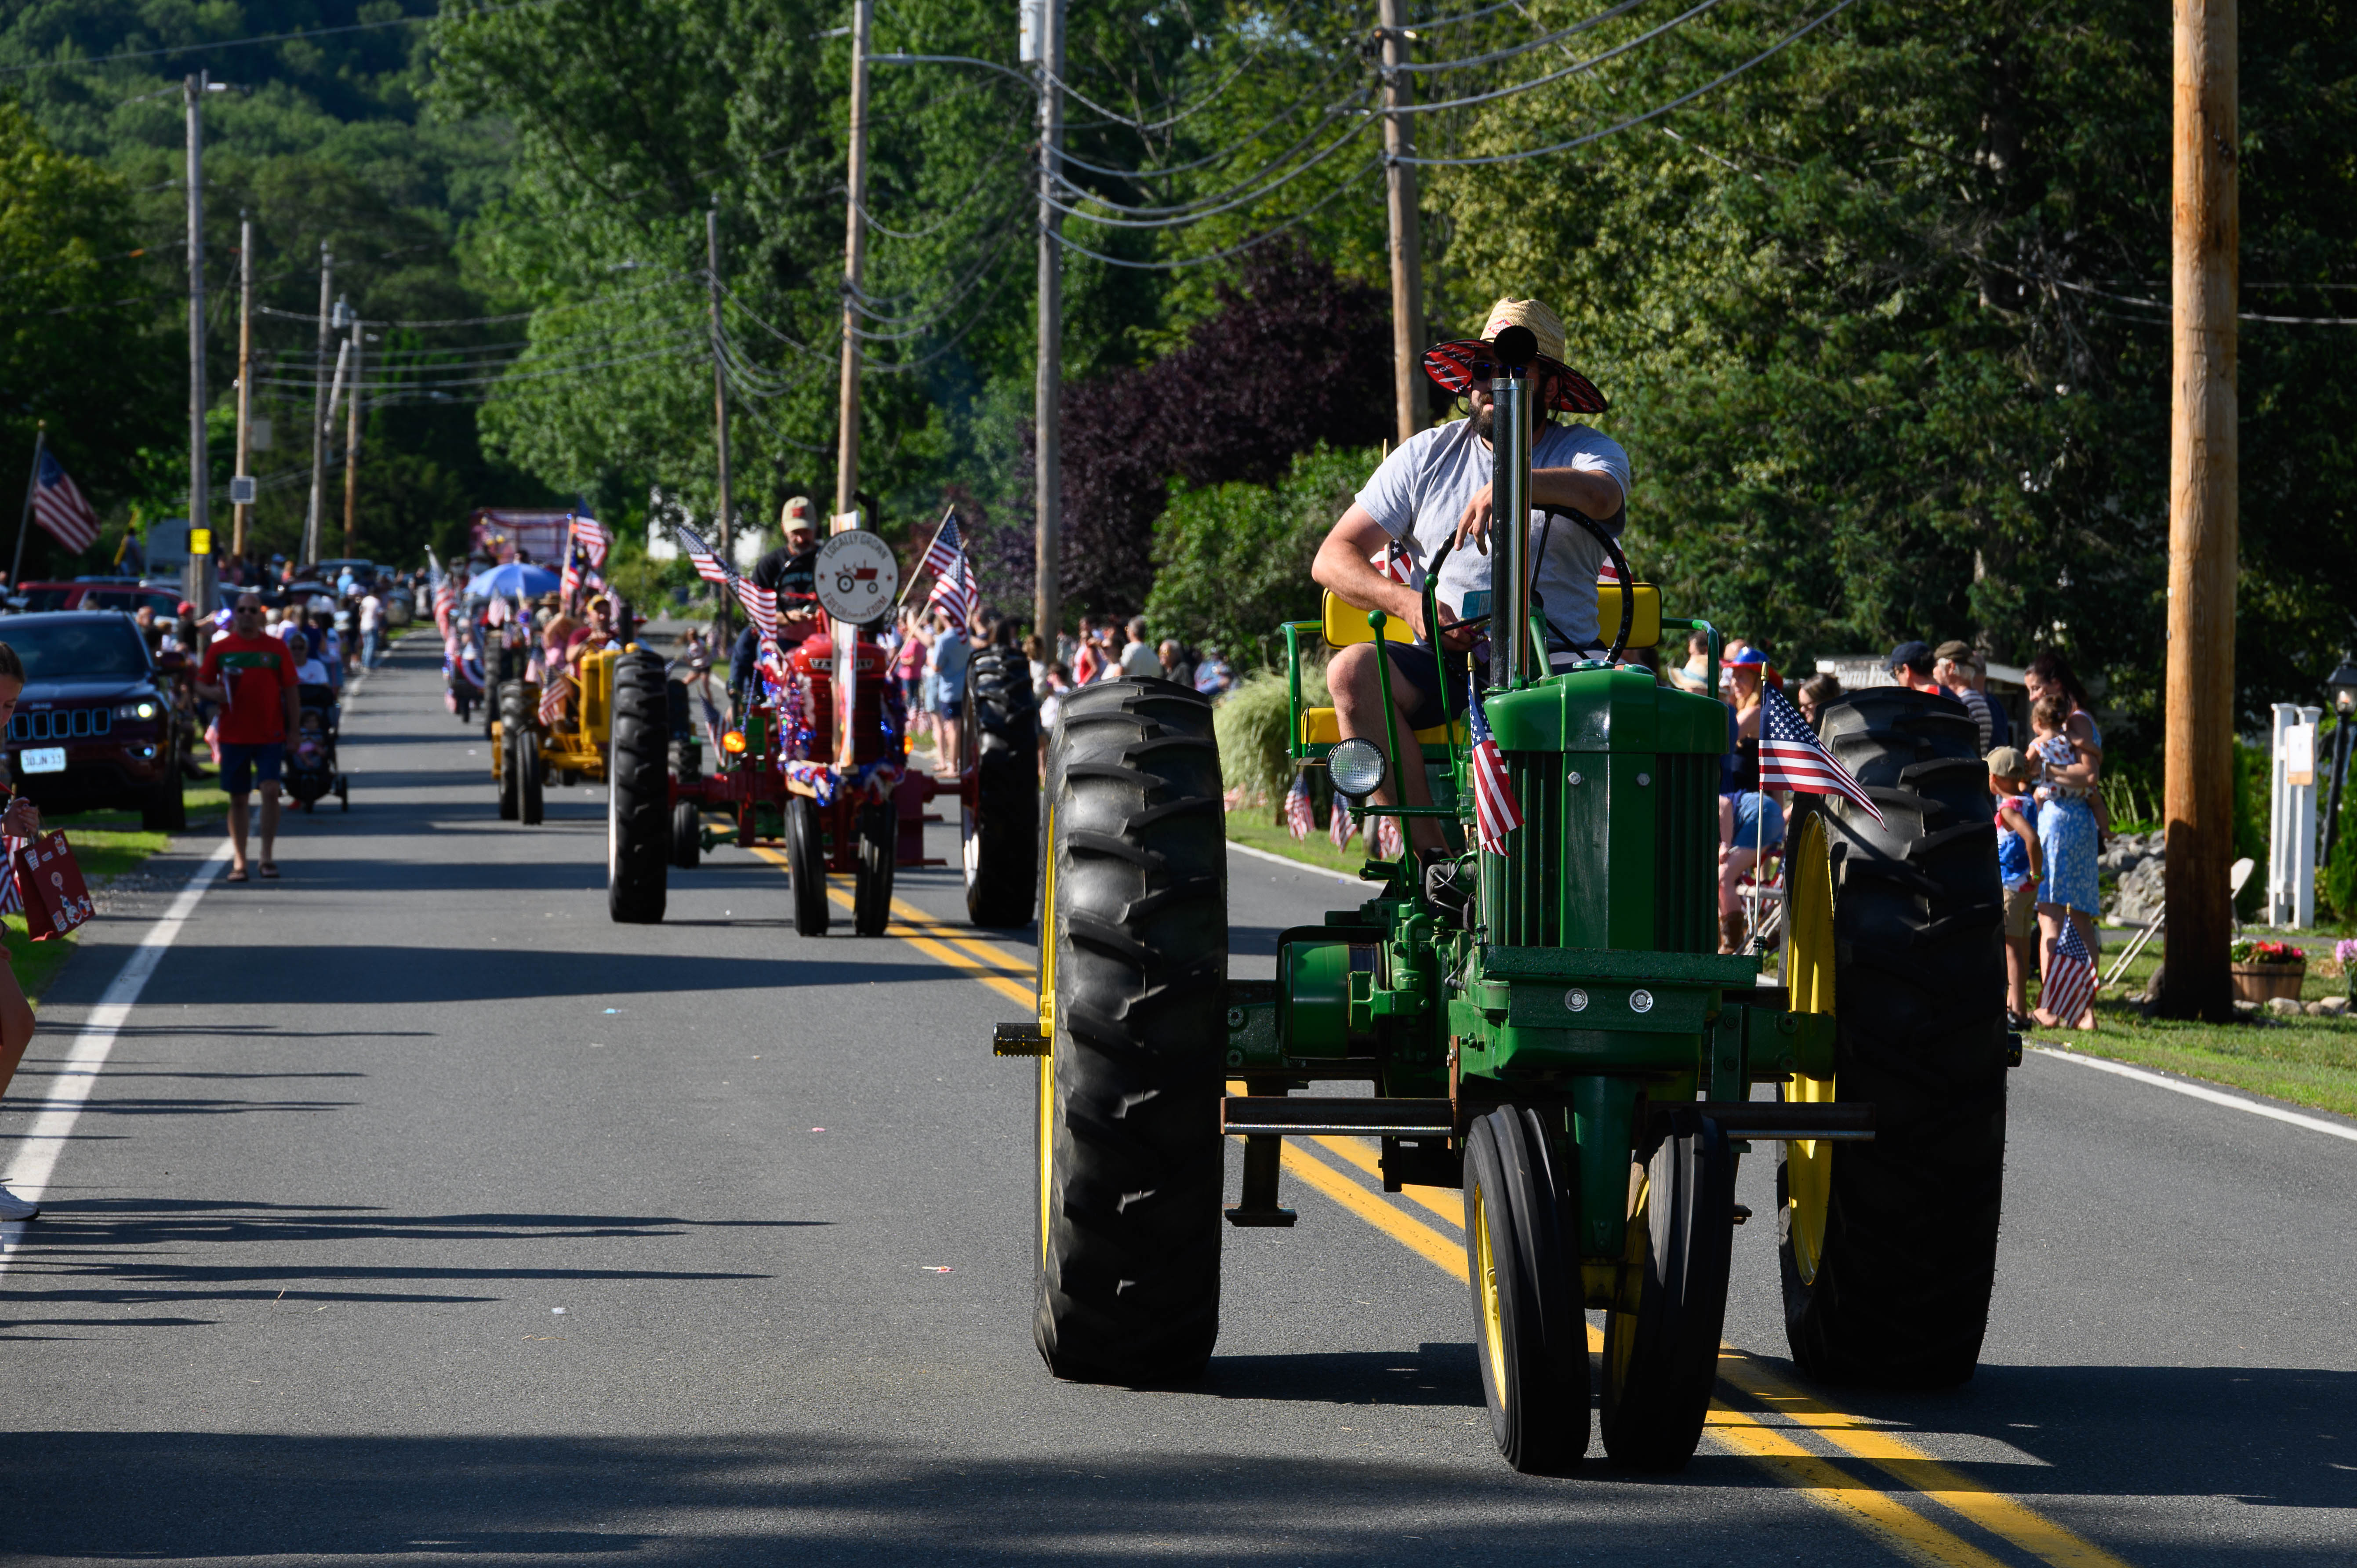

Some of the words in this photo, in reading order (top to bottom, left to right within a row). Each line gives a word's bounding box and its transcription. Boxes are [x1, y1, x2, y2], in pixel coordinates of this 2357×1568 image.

[1432, 364, 1453, 374] VGG
[824, 534, 858, 559] LOCALLY
[860, 534, 889, 559] GROWN
[822, 592, 847, 615] FRESH
[867, 594, 888, 617] FARM
